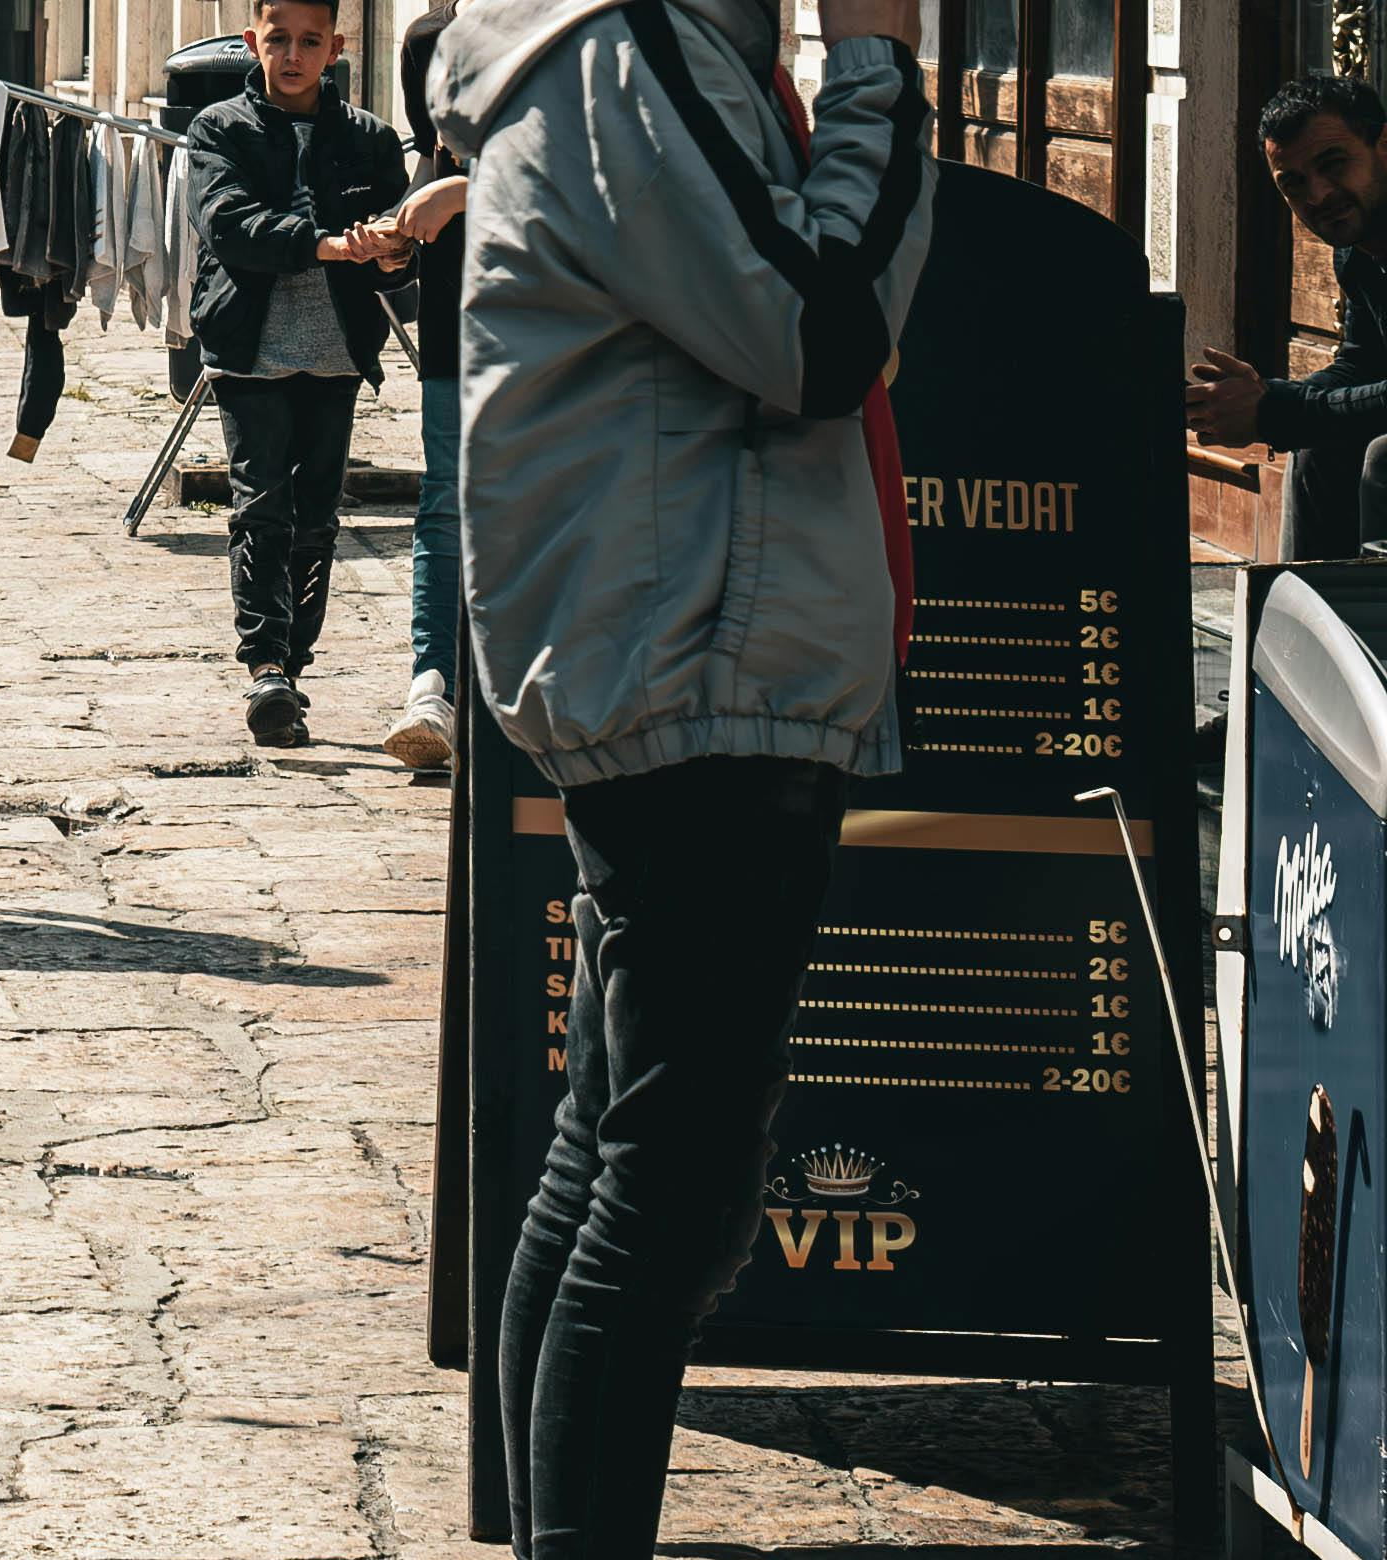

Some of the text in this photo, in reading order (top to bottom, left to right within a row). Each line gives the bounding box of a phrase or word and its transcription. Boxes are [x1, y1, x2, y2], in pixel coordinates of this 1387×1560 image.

[957, 478, 1079, 532] VEDAT
[1079, 589, 1118, 614] 5€
[1080, 625, 1120, 649] 2€
[1082, 661, 1120, 686] 1€
[1083, 697, 1122, 721] 1€
[1035, 731, 1123, 758] 2-20€
[1273, 821, 1337, 969] Milka
[1088, 920, 1128, 944] 5€
[1088, 956, 1129, 981] 2€
[1091, 994, 1129, 1019] 1€
[1091, 1031, 1131, 1056] 1€
[1042, 1067, 1132, 1094] 2-20€
[764, 1207, 917, 1271] VIP
